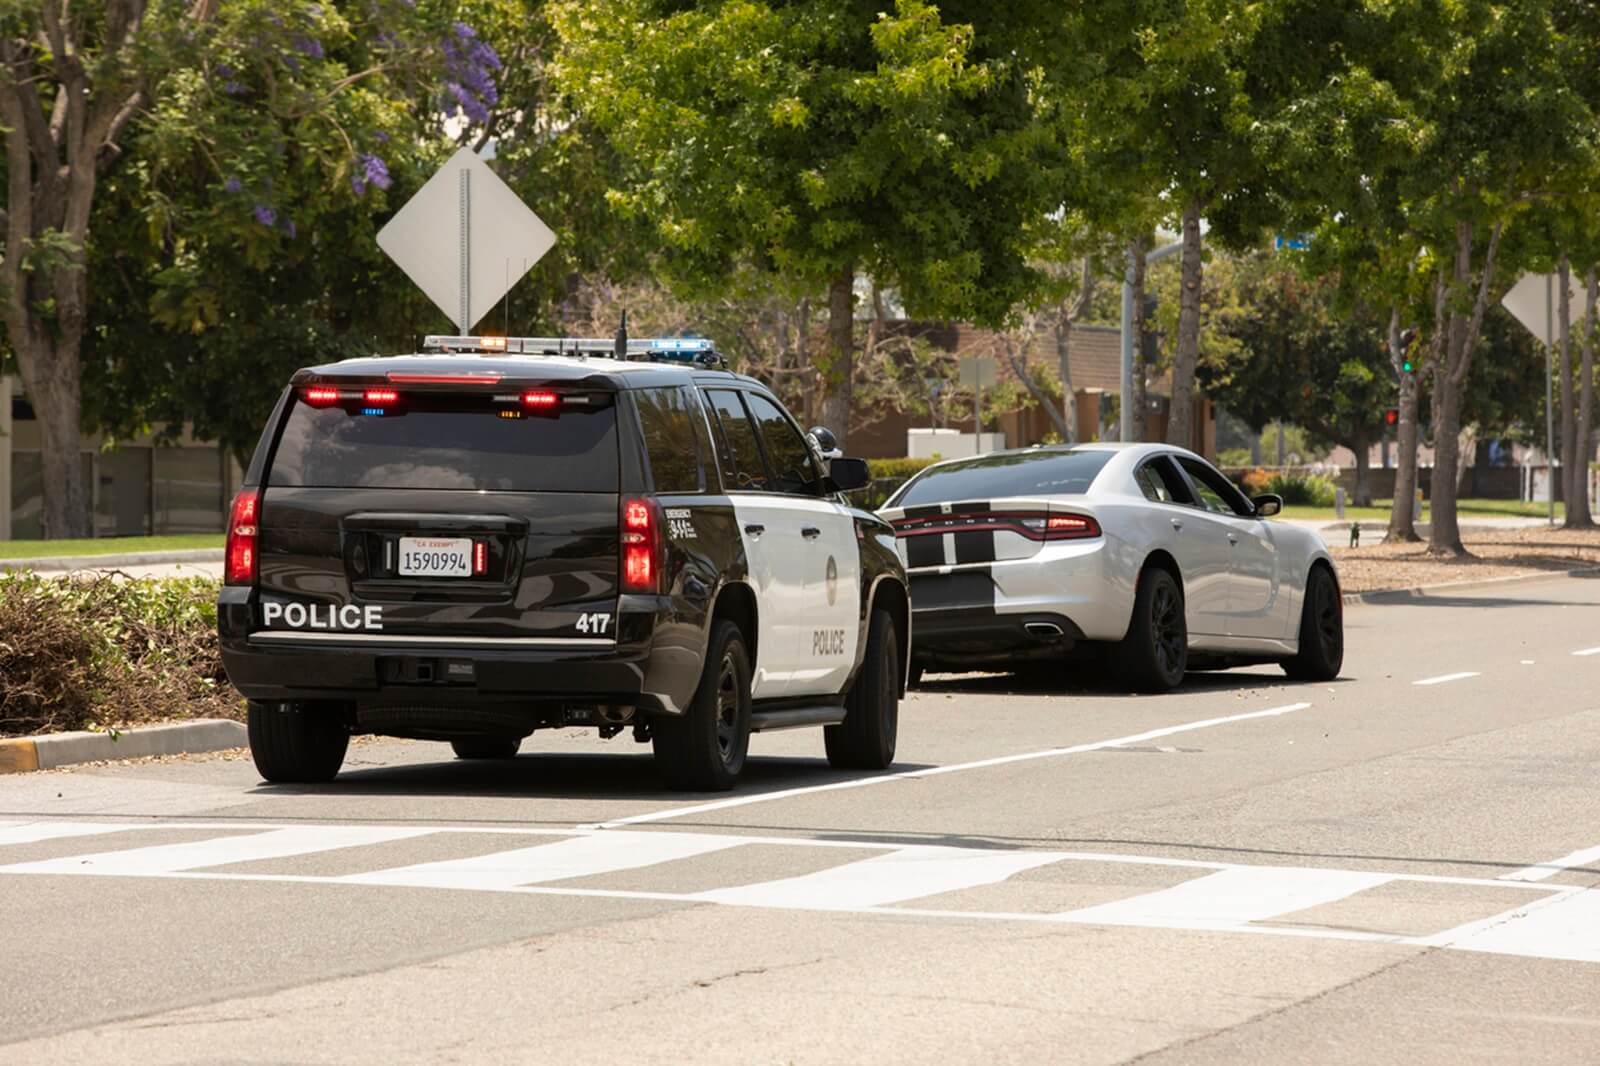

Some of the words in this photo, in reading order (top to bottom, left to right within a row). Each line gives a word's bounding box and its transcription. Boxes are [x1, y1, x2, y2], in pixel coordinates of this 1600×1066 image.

[404, 552, 466, 571] 1590994
[263, 602, 384, 629] POLICE
[575, 612, 611, 633] 417
[812, 629, 846, 656] POLICE
